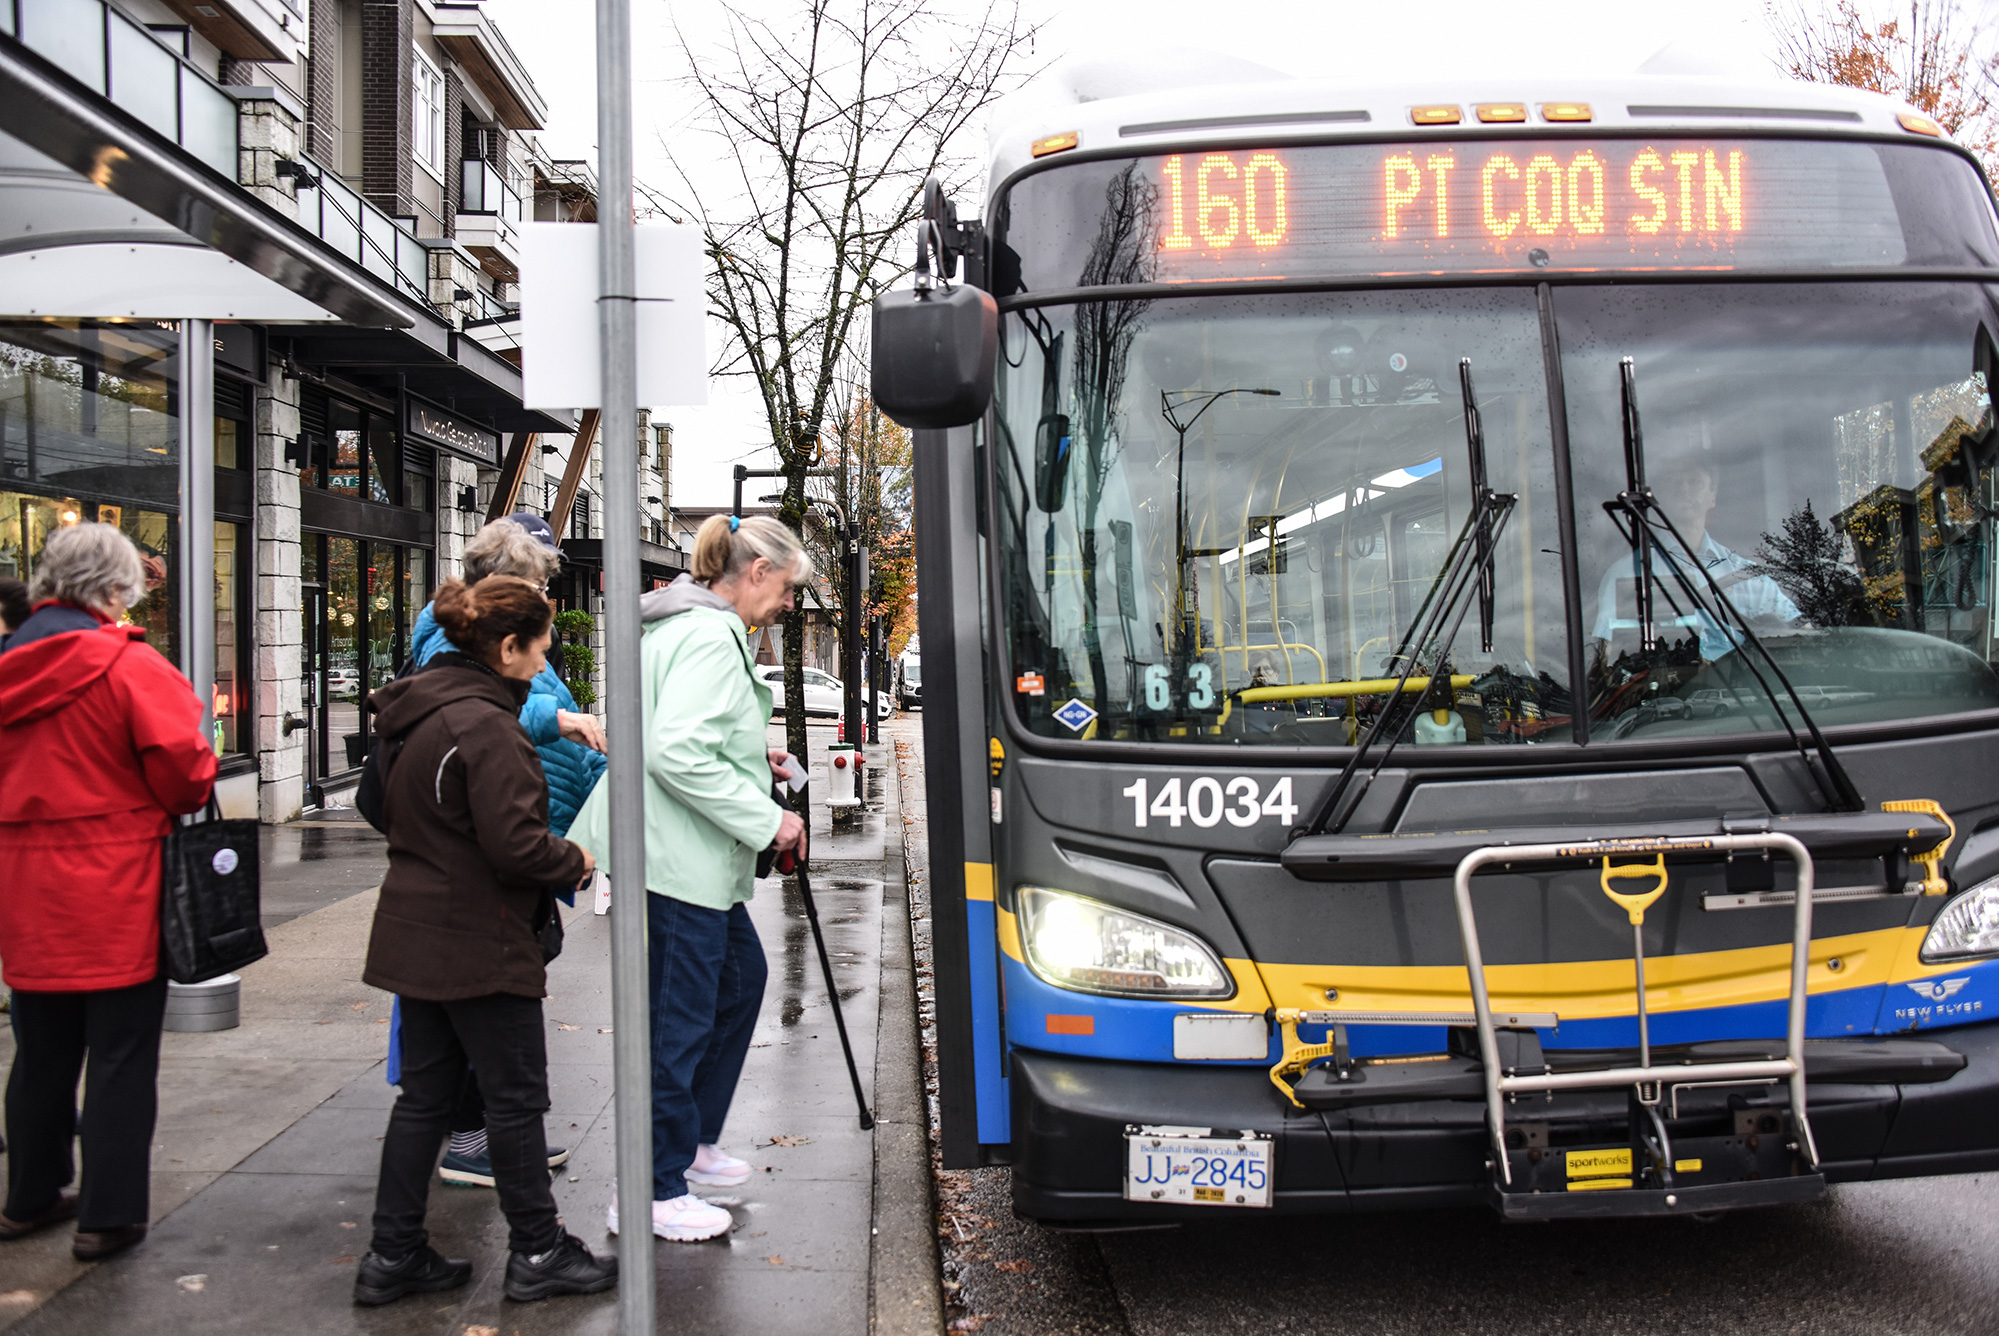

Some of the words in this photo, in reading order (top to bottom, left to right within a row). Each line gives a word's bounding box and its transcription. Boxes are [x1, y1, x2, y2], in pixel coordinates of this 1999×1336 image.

[1162, 153, 1289, 249] 160
[1382, 153, 1456, 240] PT
[1482, 153, 1606, 236] COQ
[1629, 150, 1744, 233] STN
[1122, 776, 1299, 828] 14034
[1895, 1006, 1932, 1019] NEW
[1936, 1001, 1983, 1016] FLYER
[1140, 1144, 1181, 1153] Beautiful
[1183, 1145, 1213, 1155] British
[1214, 1146, 1260, 1158] Columbia
[1568, 1155, 1629, 1169] sportworks
[1135, 1155, 1171, 1184] JJ
[1191, 1157, 1266, 1189] 2845
